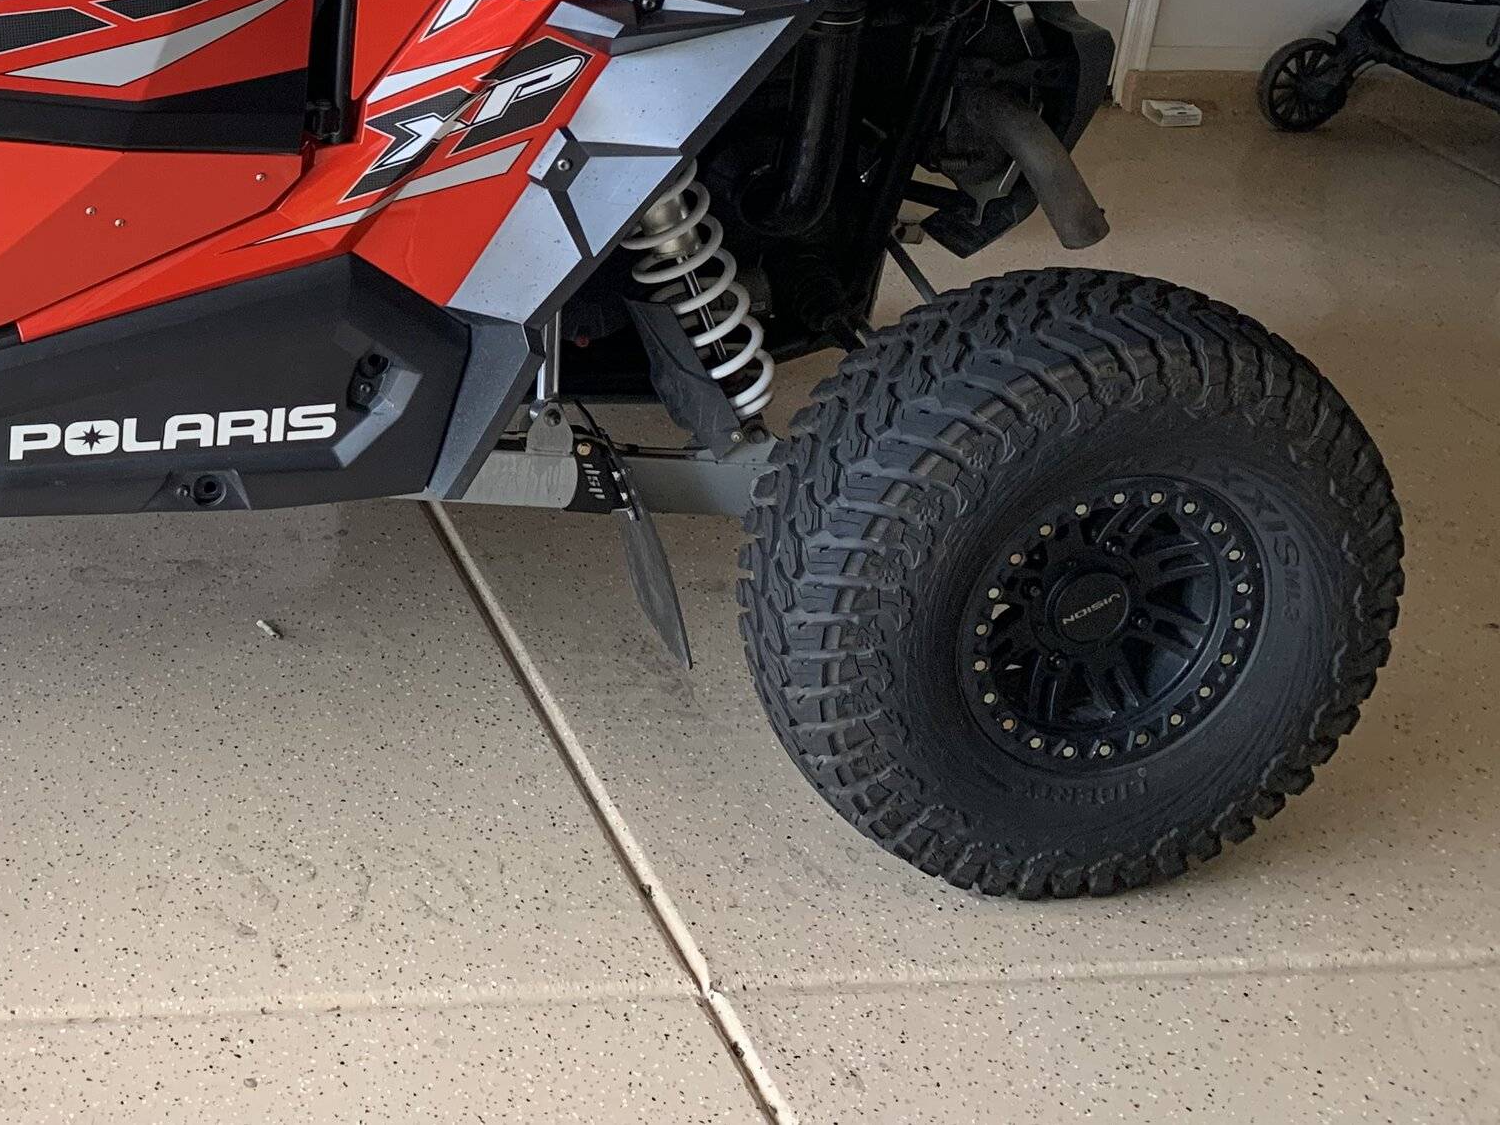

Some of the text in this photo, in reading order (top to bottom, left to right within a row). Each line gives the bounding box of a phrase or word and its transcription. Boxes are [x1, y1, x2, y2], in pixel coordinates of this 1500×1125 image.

[369, 54, 585, 175] XP
[9, 403, 337, 460] POLARIS
[1062, 593, 1121, 625] VISION
